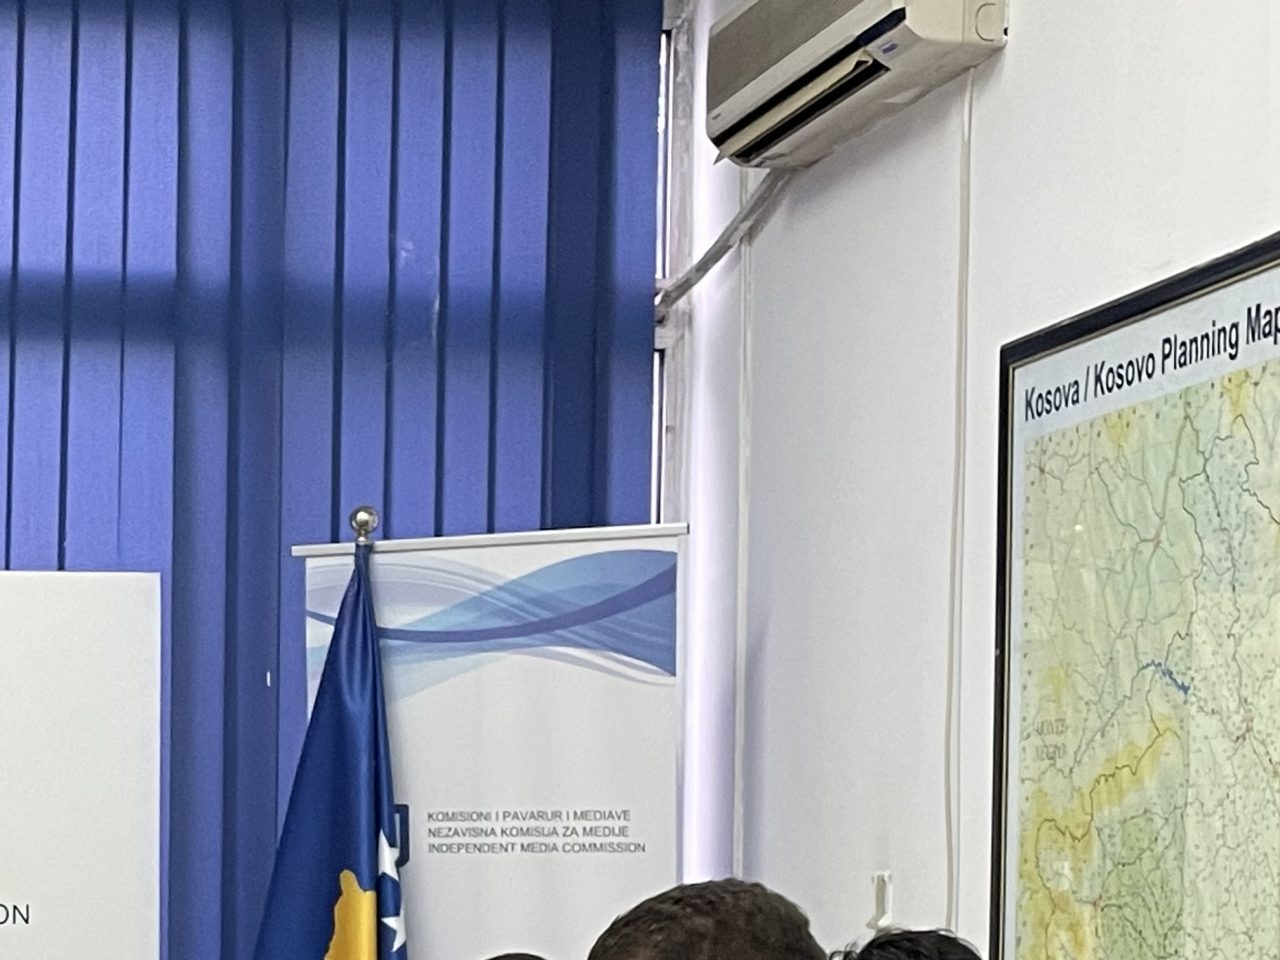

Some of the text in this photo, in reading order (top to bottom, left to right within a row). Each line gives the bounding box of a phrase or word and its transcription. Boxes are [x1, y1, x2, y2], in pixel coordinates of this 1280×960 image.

[1024, 379, 1080, 422] Kosova
[1084, 365, 1090, 402] /
[1093, 352, 1156, 398] Kosovo
[1161, 319, 1240, 375] Planning
[427, 811, 492, 822] KOMISIONI
[502, 811, 563, 822] PAVARUR
[573, 809, 631, 821] MEDIAVE
[427, 825, 629, 838] NEZAVISNA KOMISIJA ZA MEDIJE
[427, 841, 646, 854] INDEPENDENT MEDIA COMMISSION
